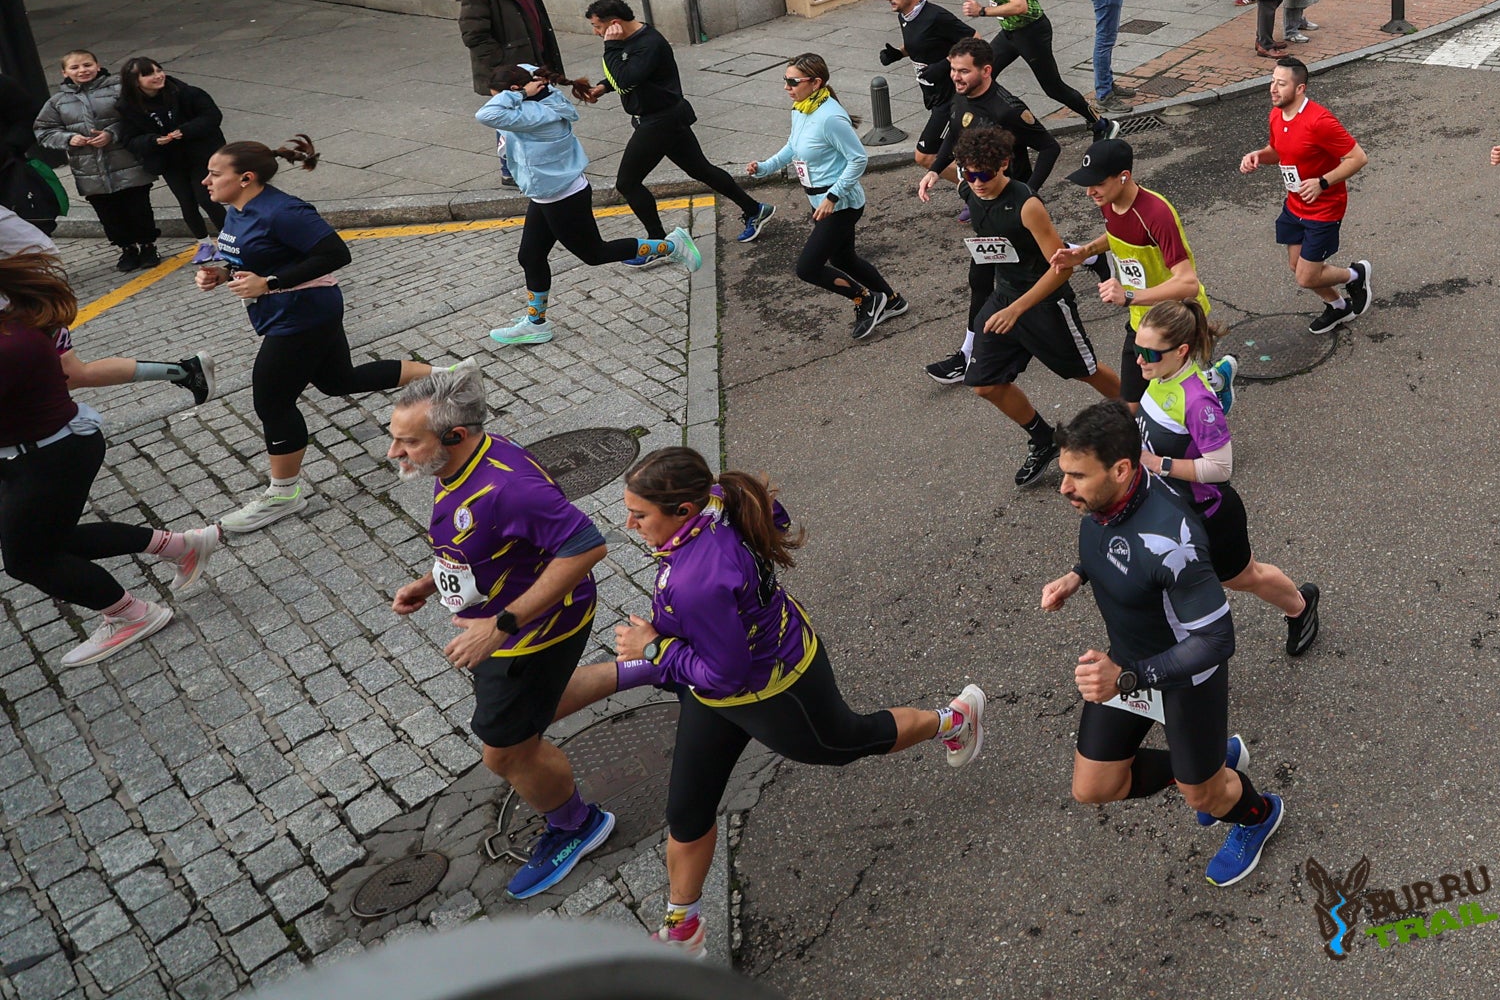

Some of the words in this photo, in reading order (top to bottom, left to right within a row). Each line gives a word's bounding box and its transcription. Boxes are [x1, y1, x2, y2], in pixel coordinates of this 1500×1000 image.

[975, 244, 1006, 254] 447
[440, 571, 461, 593] 68
[551, 838, 582, 867] HOKA
